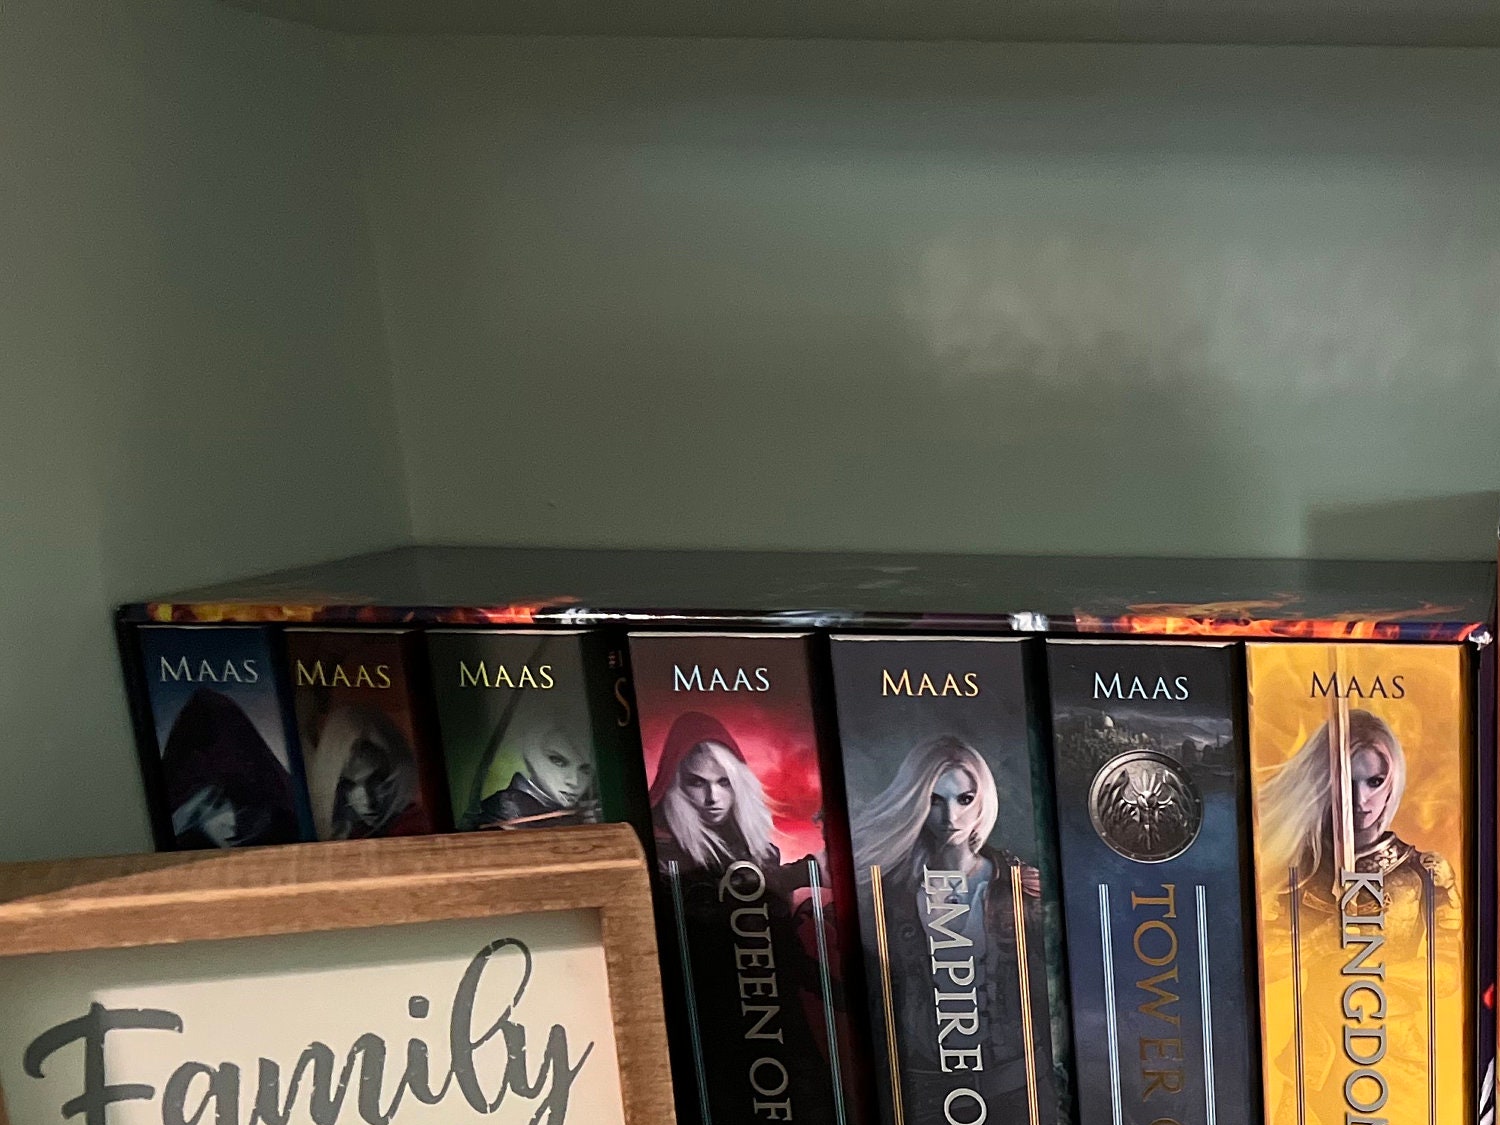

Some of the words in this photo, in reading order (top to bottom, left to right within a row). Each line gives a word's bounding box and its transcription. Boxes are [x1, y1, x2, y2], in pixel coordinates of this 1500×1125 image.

[160, 655, 259, 685] MAAS
[296, 658, 392, 690] MAAS
[459, 660, 555, 691] MAAS
[673, 664, 771, 693] MAAS
[882, 669, 979, 697] MAAS
[1093, 671, 1190, 700] MAAS
[1310, 671, 1406, 699] MAAS
[718, 860, 785, 1046] QUEEN
[924, 862, 985, 1073] EMPIRE
[1131, 884, 1186, 1102] TOWER
[749, 1056, 793, 1121] OF
